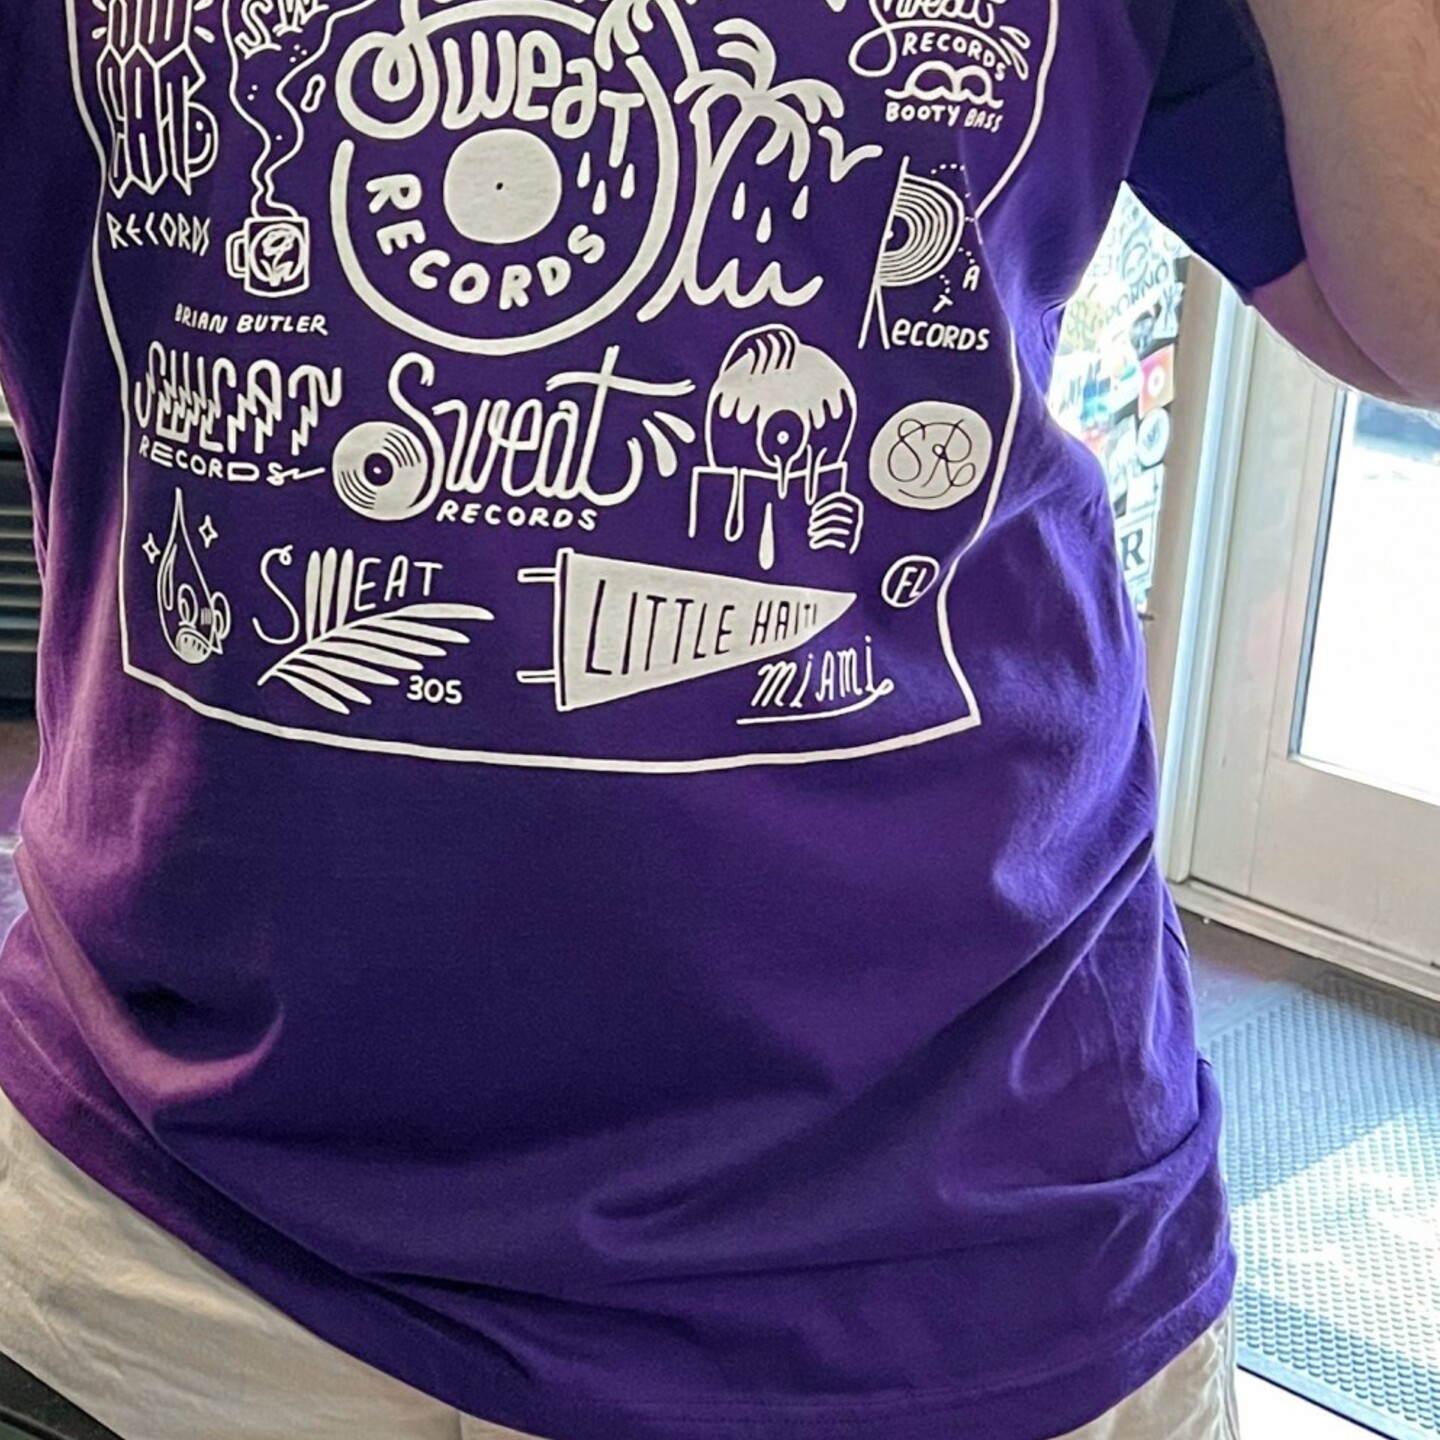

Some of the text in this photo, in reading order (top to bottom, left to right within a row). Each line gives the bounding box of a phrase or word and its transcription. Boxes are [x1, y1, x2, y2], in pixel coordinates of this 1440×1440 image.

[902, 31, 1007, 81] RECORDS
[885, 100, 1003, 133] BOOTY BASS
[106, 210, 211, 257] RECORDS
[365, 173, 606, 310] RECORDS
[174, 303, 329, 336] BRIAN BUTLER
[332, 345, 695, 521] Sweat
[139, 434, 325, 486] RECORDS
[436, 500, 598, 531] RECORDS
[586, 580, 818, 676] LITTLE HAITI
[407, 675, 462, 704] 305
